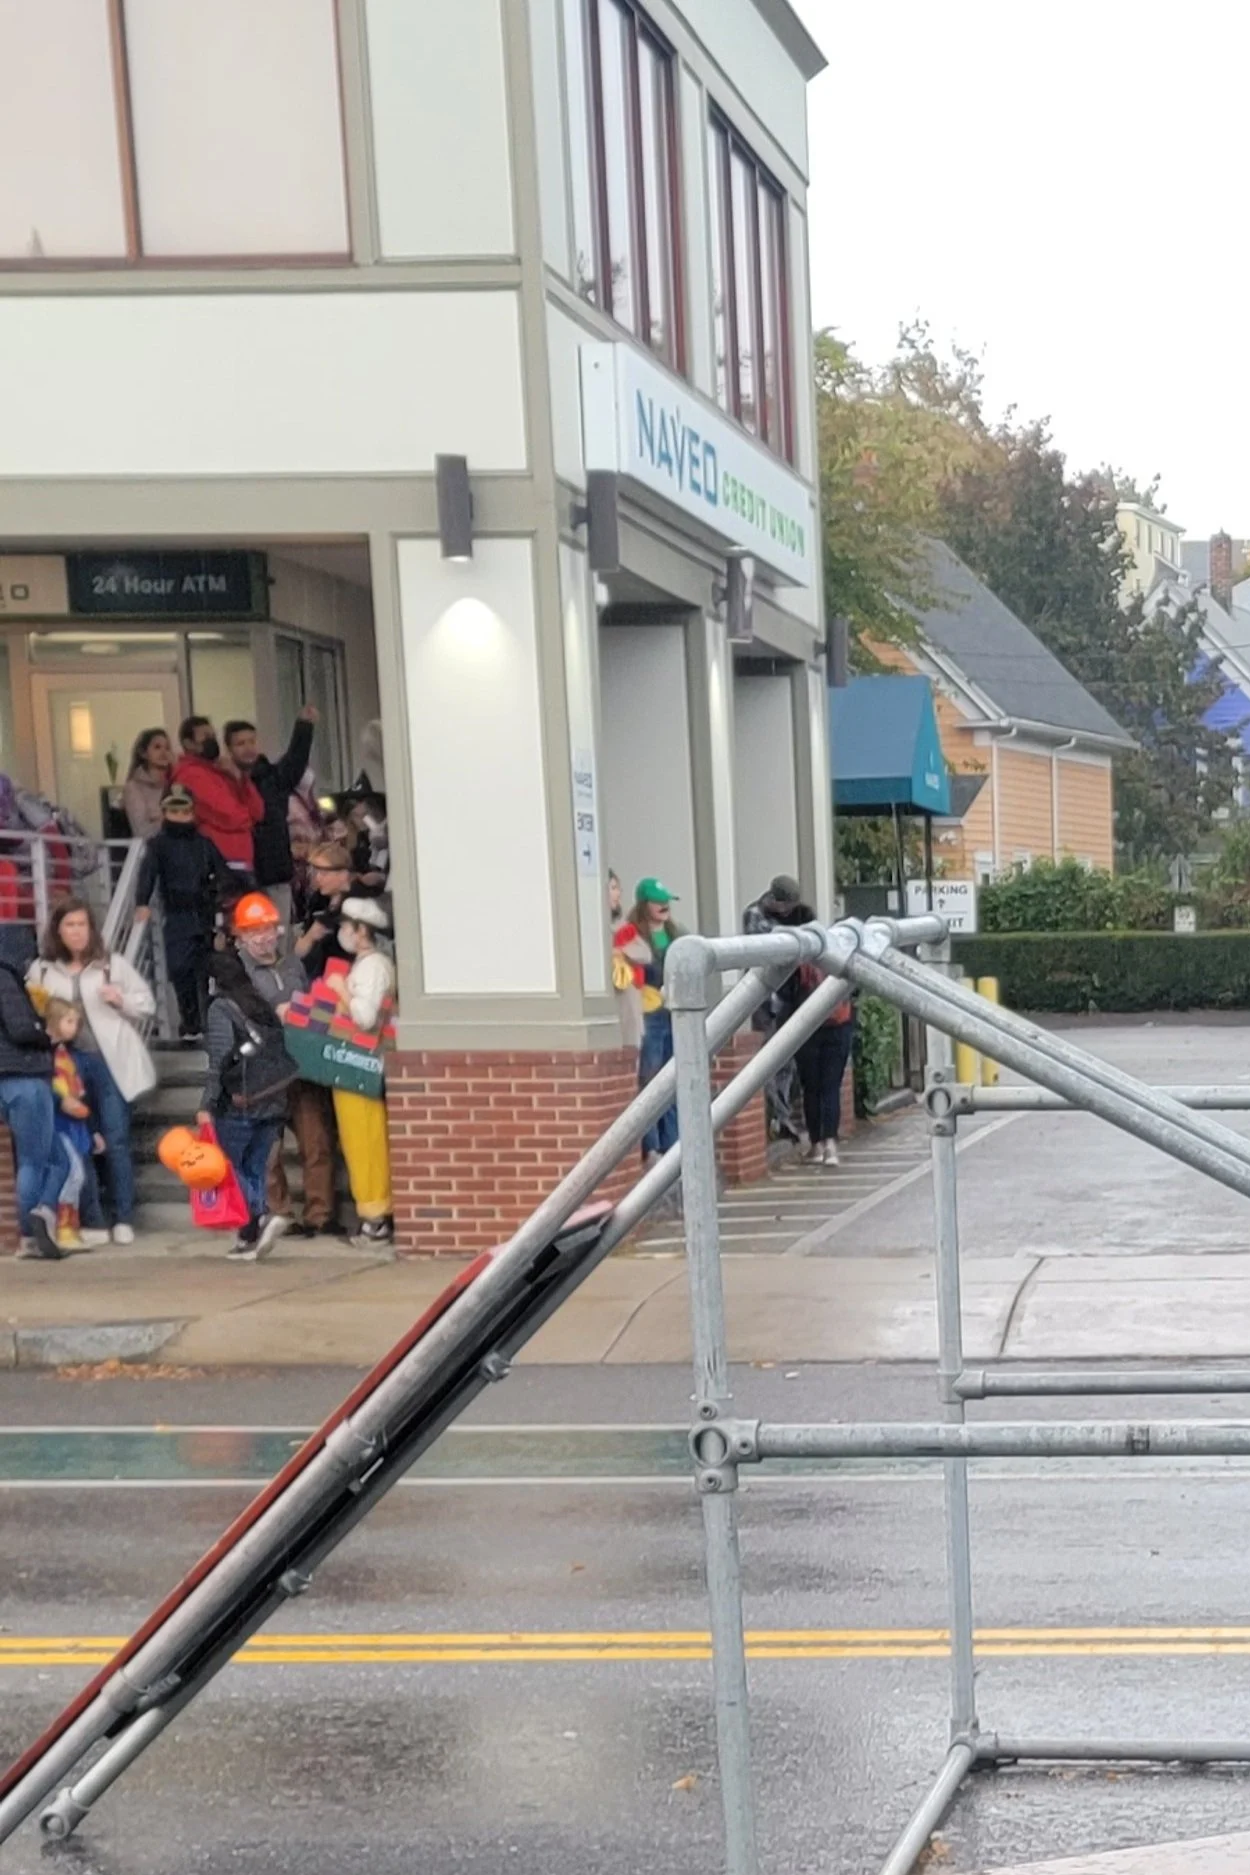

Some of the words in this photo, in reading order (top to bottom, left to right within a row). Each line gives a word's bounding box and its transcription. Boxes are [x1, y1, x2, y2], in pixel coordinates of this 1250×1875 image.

[636, 389, 718, 508] NAVEO
[722, 471, 766, 532] CREDIT
[769, 504, 805, 558] UNION
[92, 575, 117, 594] 24
[123, 575, 176, 594] Hour
[181, 574, 227, 593] ATM
